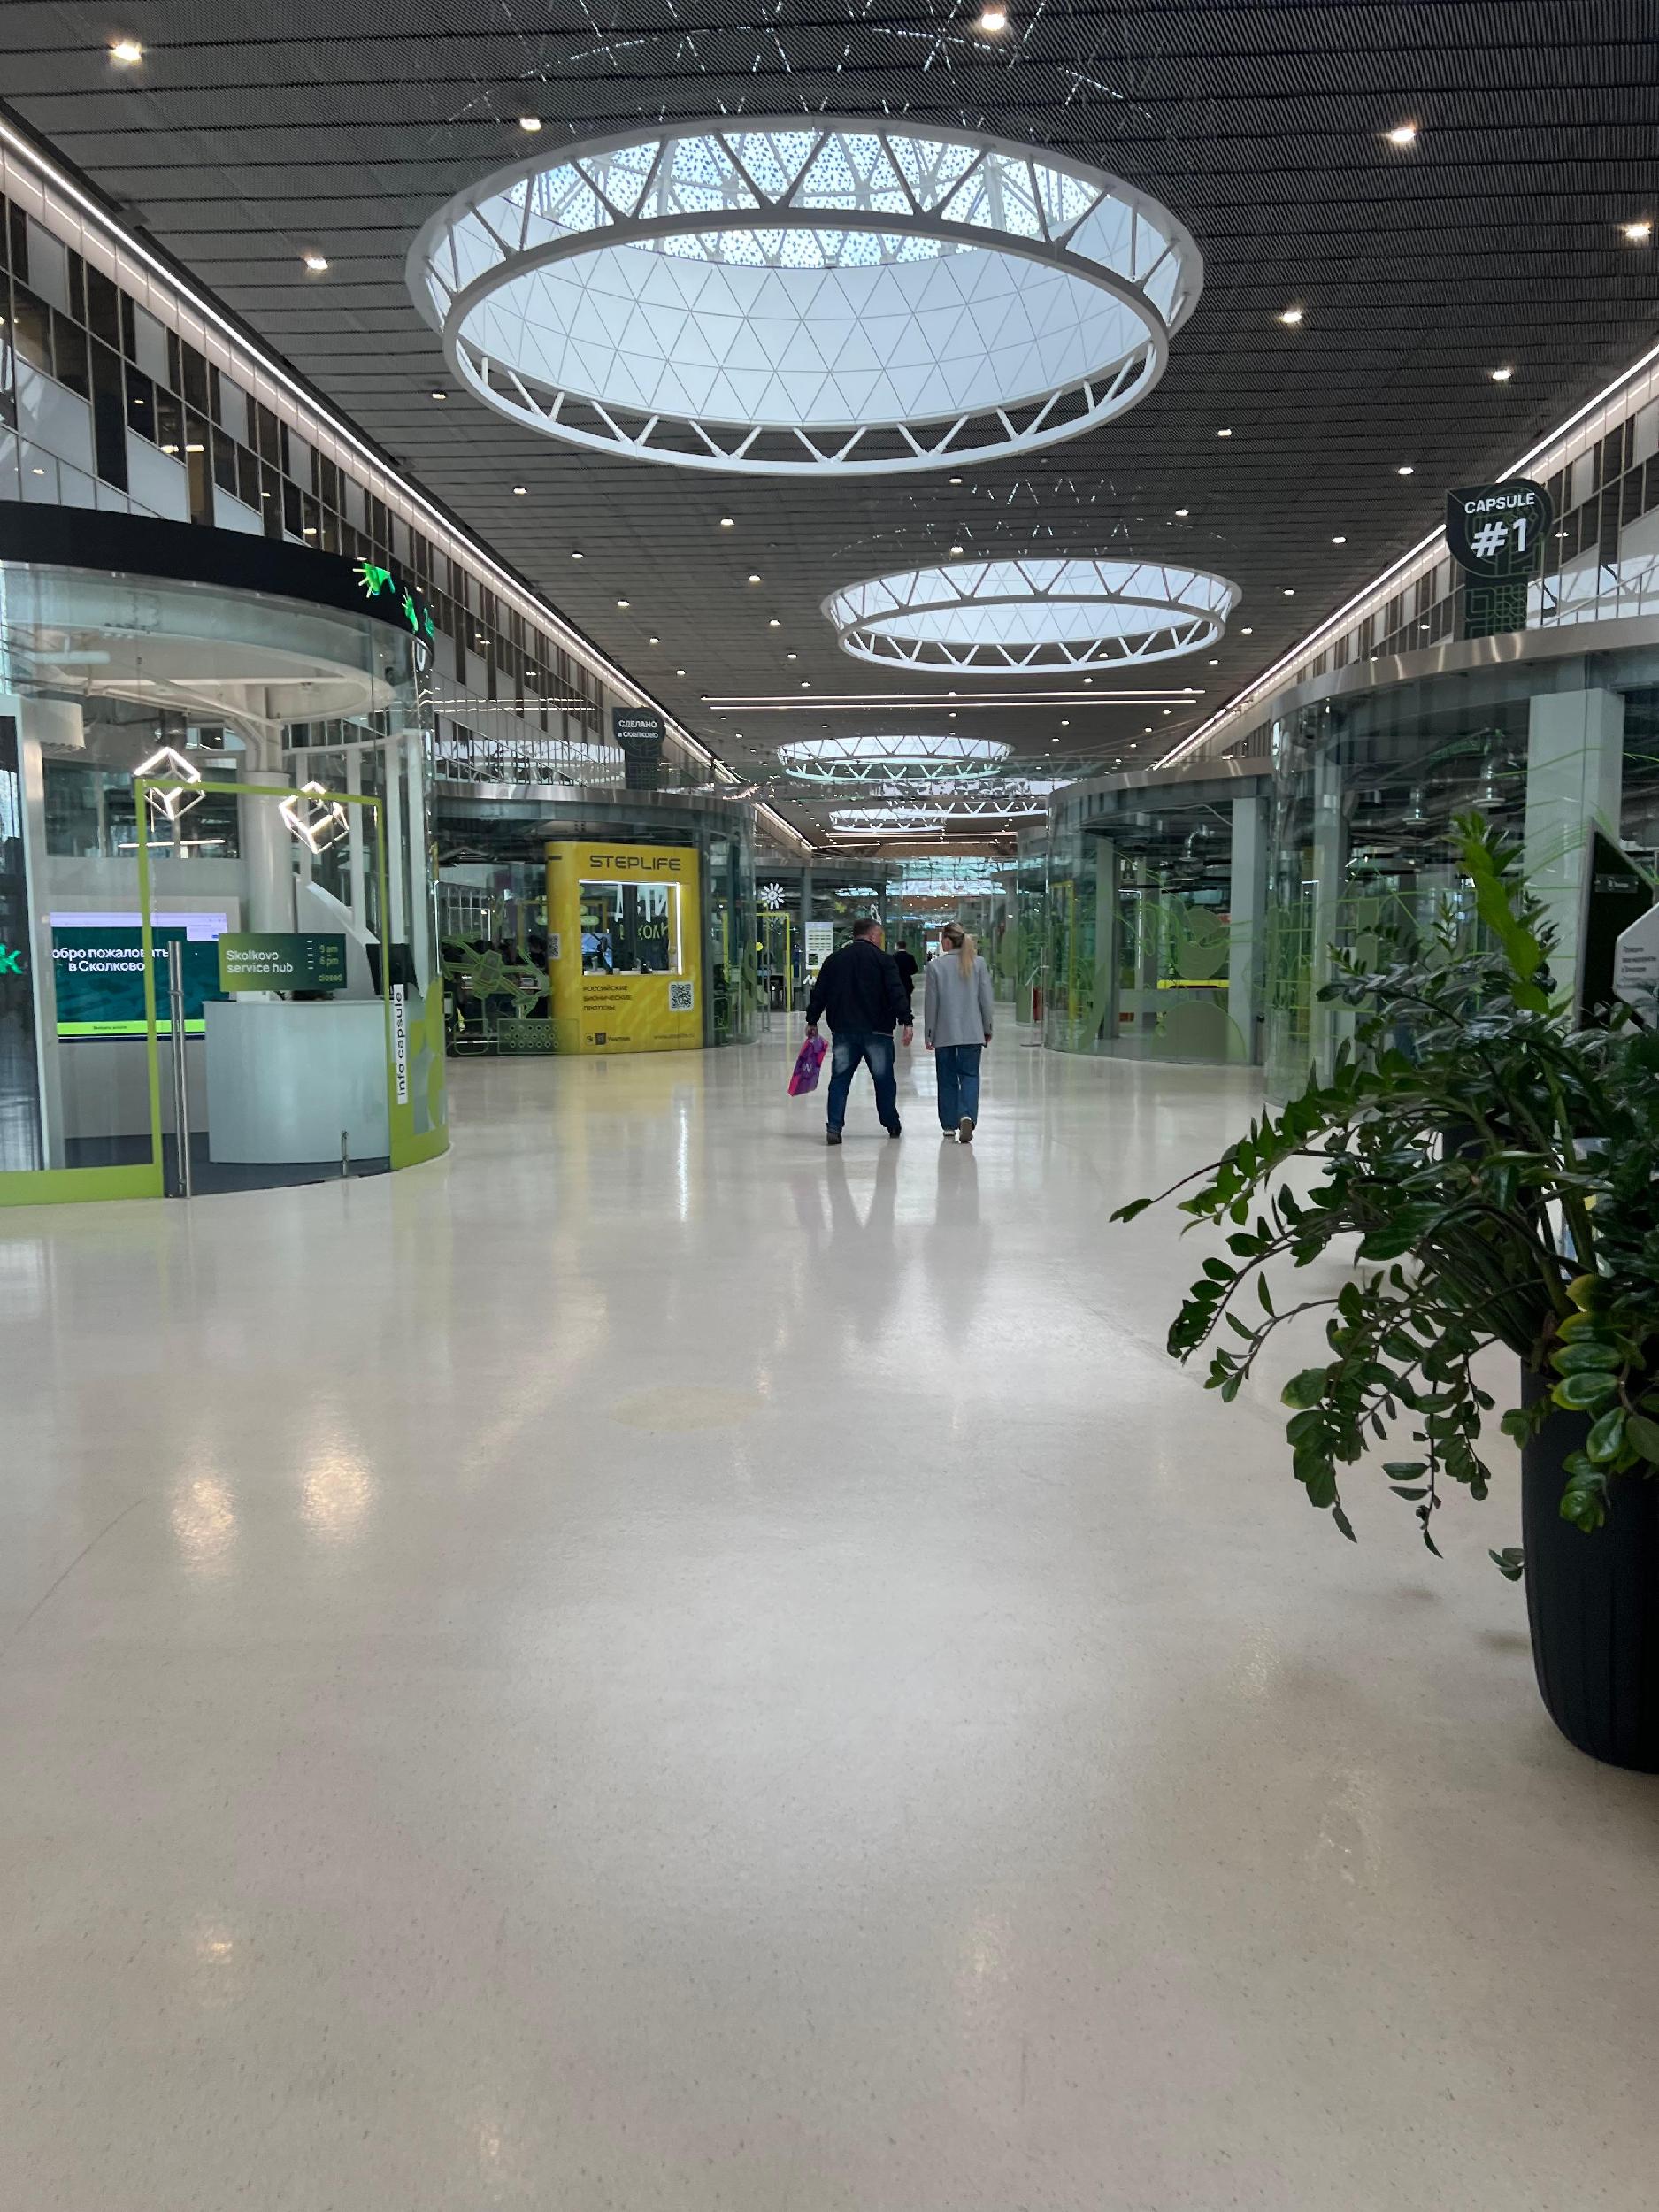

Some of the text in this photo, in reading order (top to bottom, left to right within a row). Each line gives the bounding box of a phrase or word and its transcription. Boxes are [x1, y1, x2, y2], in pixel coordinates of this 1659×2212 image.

[1464, 493, 1535, 514] CAPSULE
[1471, 518, 1526, 557] #1
[589, 855, 681, 871] STEPLIFE
[52, 947, 87, 962] обро
[227, 950, 280, 961] Skolkovo
[69, 960, 145, 972] в Сколково
[227, 963, 294, 973] service hub
[395, 992, 405, 1059] capsule
